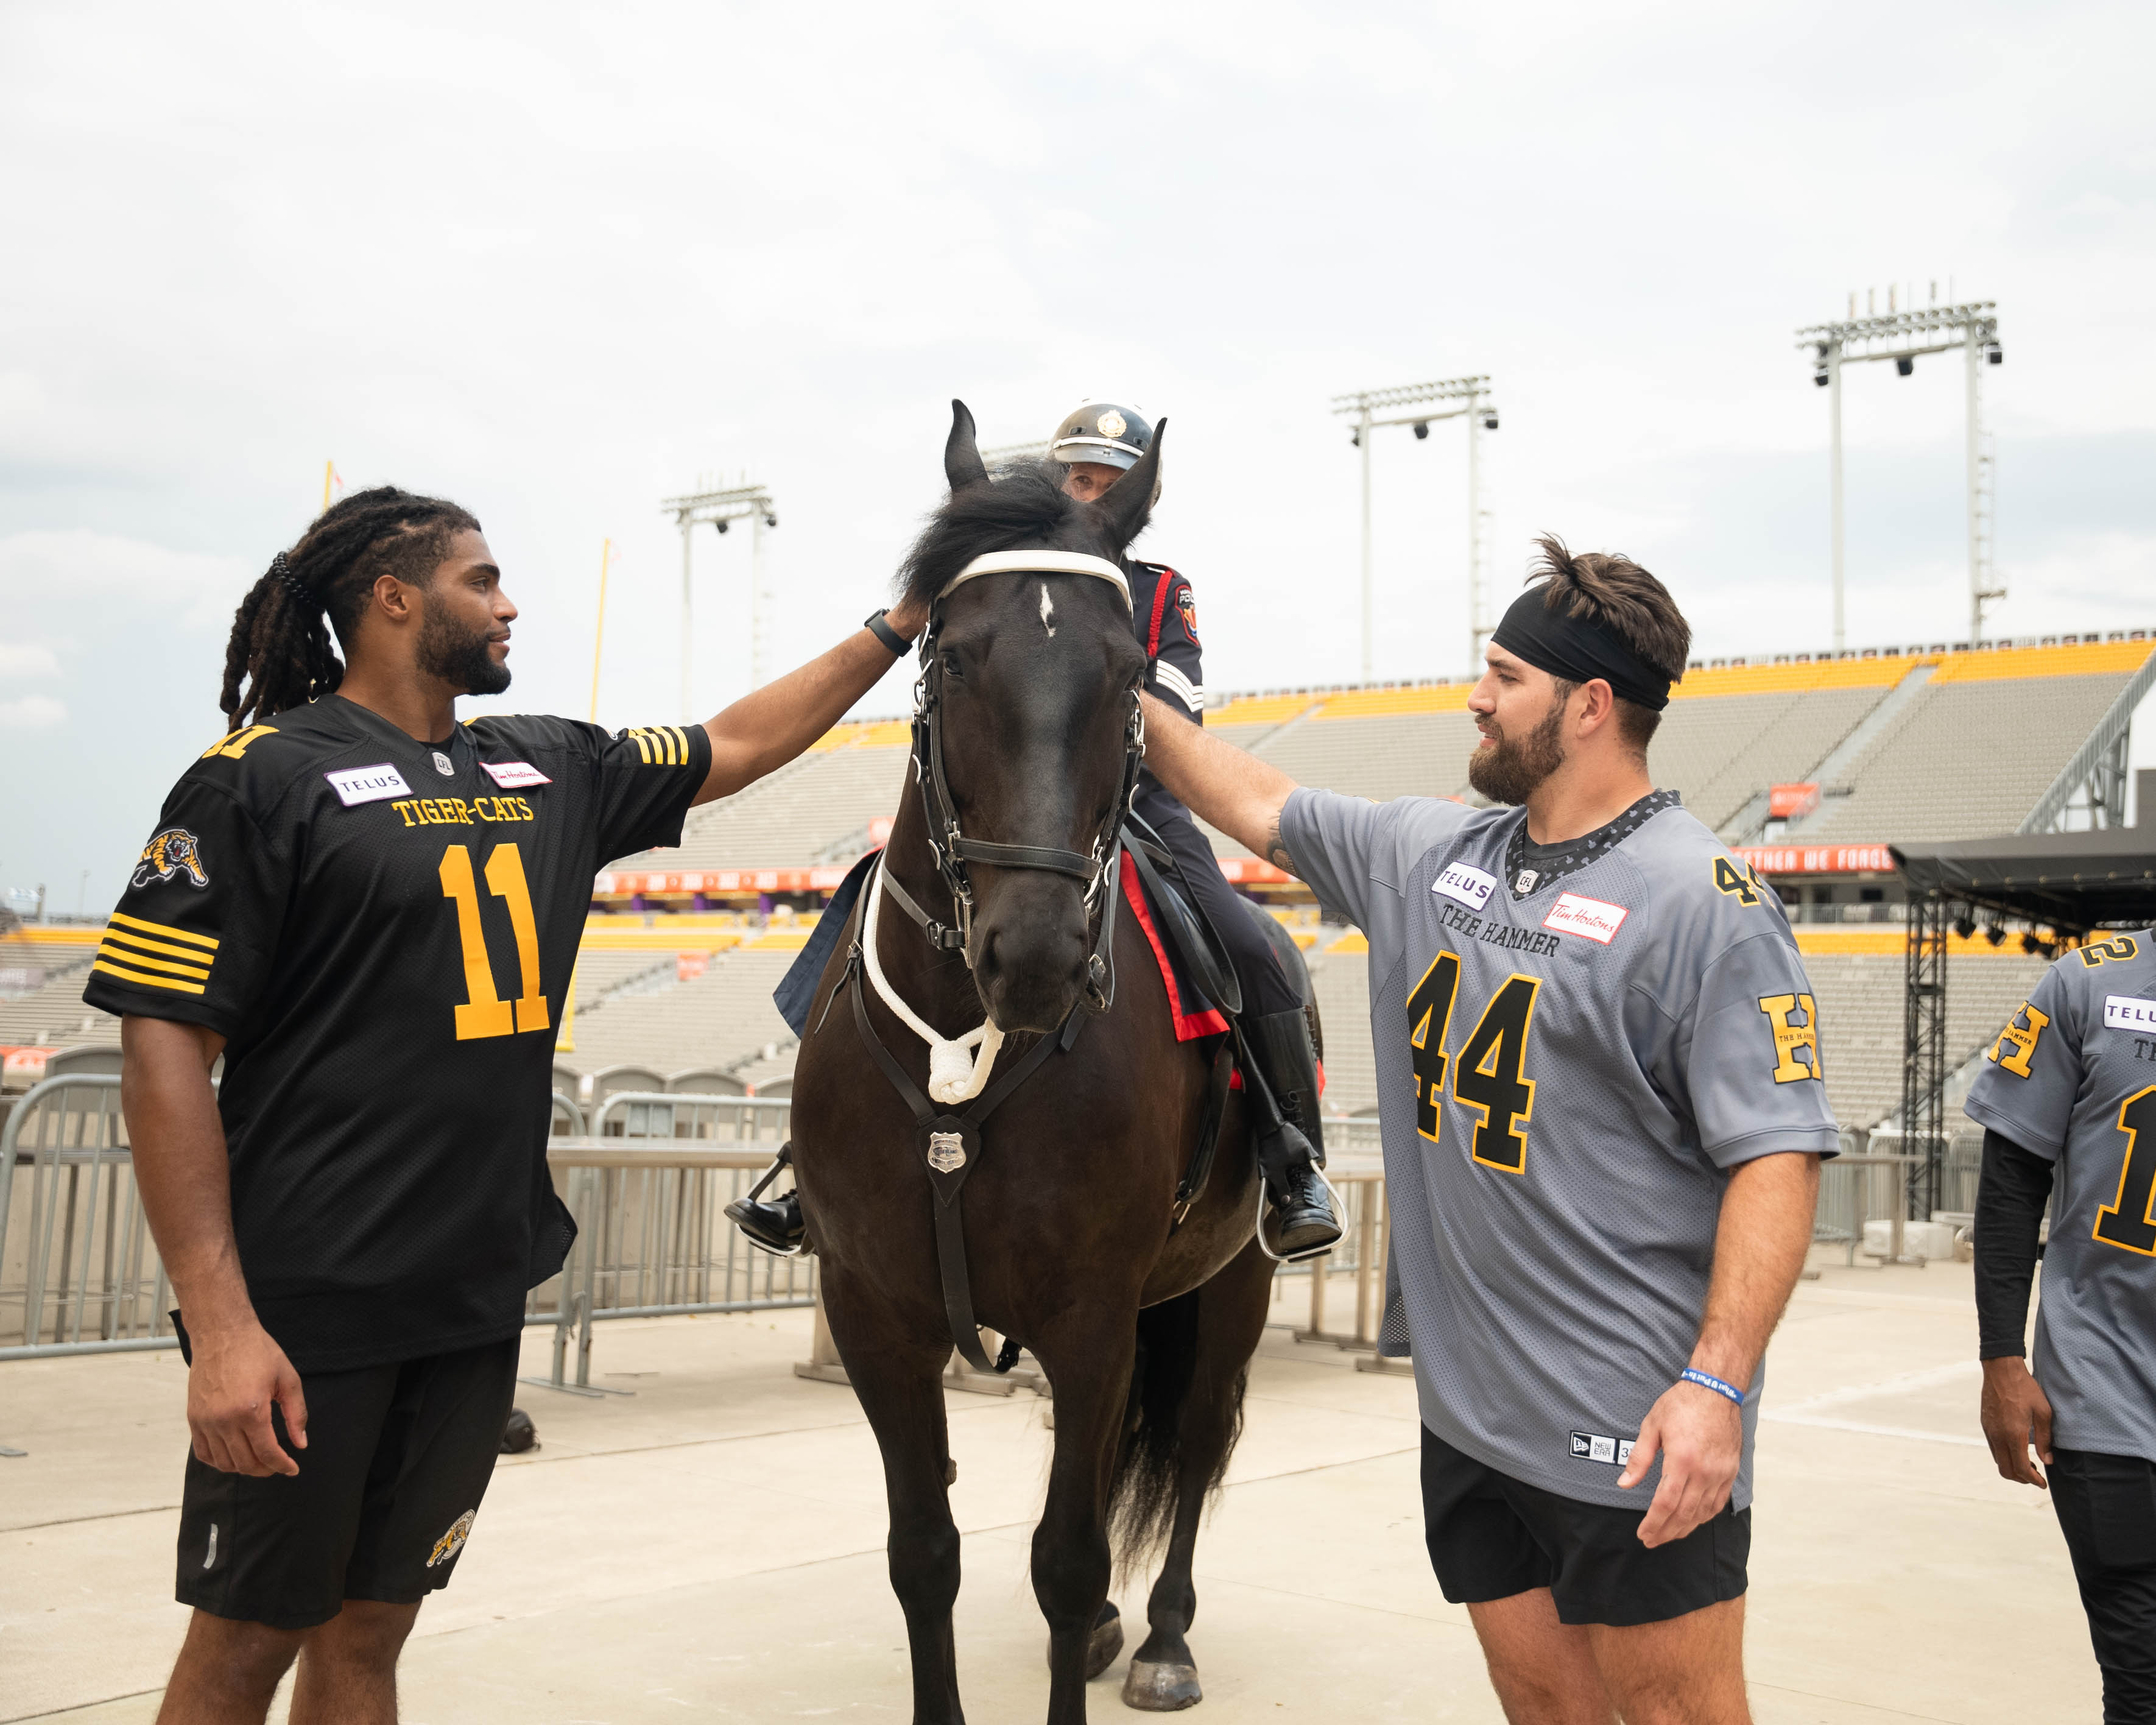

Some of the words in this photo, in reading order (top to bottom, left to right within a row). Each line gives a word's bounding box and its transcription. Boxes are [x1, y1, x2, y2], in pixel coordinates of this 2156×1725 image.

[339, 775, 401, 792] TELUS
[391, 796, 535, 827] TIGER-CATS
[1439, 870, 1490, 899] TELUS
[1519, 875, 1532, 887] CFL
[1439, 903, 1483, 938] THE
[1479, 922, 1561, 958] HAMMER
[1551, 903, 1571, 920] Tim
[1573, 908, 1615, 933] Hortons
[439, 842, 550, 1041] 11
[1406, 950, 1543, 1175] 44
[2091, 1084, 2156, 1263] 1
